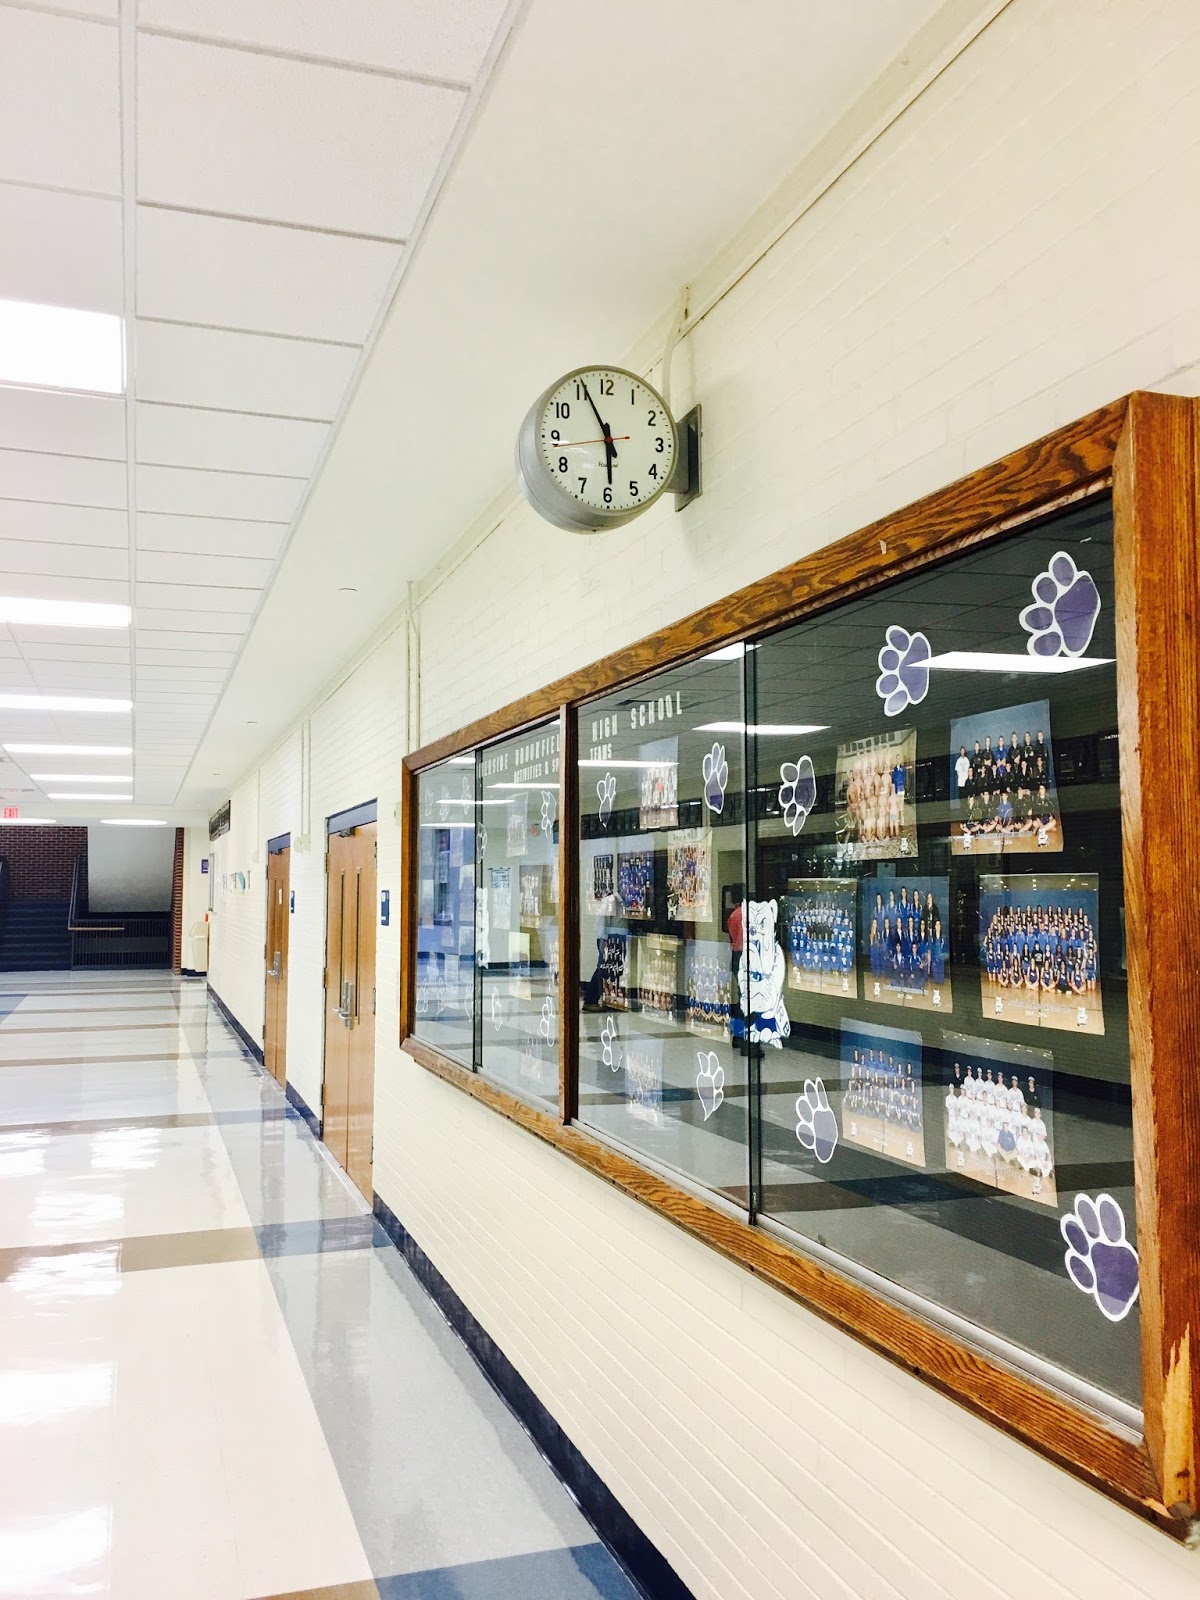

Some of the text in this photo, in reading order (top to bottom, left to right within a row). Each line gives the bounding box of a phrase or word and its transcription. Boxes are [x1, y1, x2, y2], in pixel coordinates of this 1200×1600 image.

[576, 384, 587, 401] 11
[600, 379, 614, 395] 12
[631, 389, 635, 405] 1
[556, 402, 570, 419] 10
[648, 410, 656, 426] 2
[551, 430, 560, 447] 9
[655, 437, 664, 453] 3
[558, 456, 568, 473] 8
[648, 463, 658, 480] 4
[578, 477, 587, 494] 7
[629, 481, 638, 497] 5
[603, 487, 612, 503] 6
[515, 734, 560, 767] BROOKFIEL
[592, 714, 618, 742] HIGH
[630, 691, 683, 729] SCHOOL
[590, 743, 612, 761] TEAMS
[4, 807, 19, 818] EXIT
